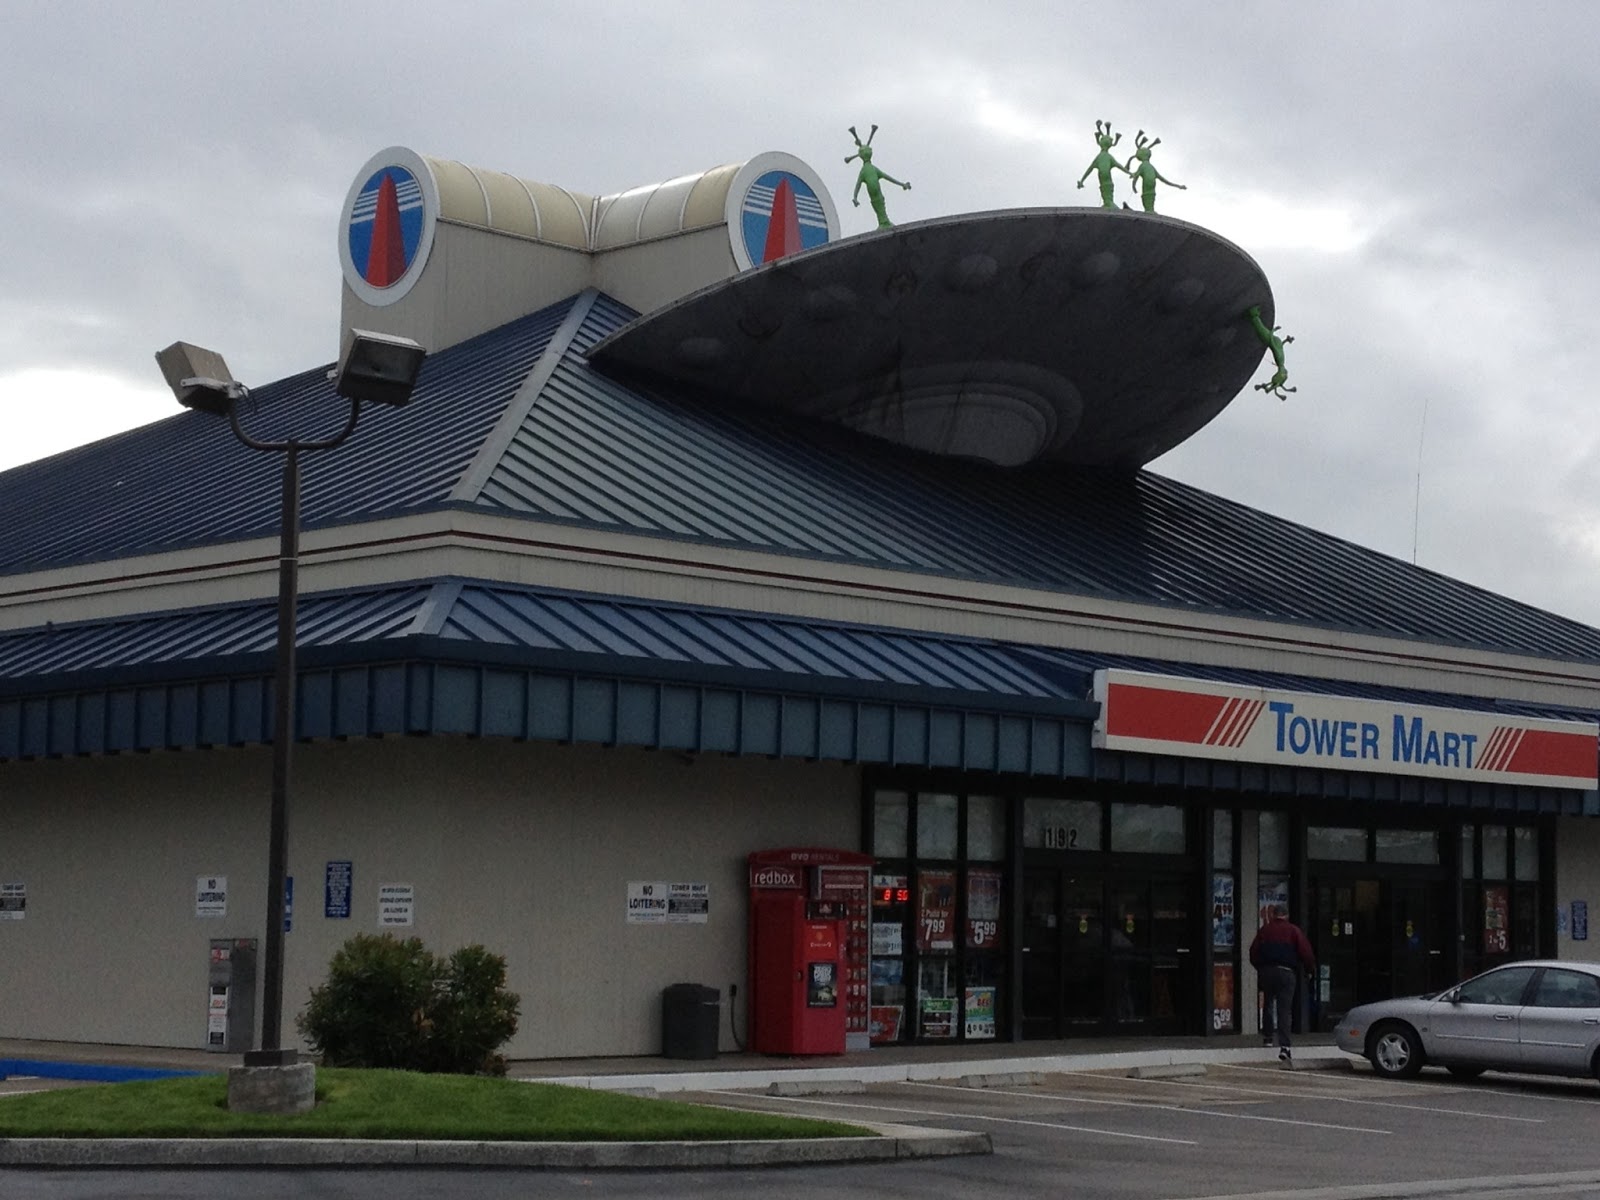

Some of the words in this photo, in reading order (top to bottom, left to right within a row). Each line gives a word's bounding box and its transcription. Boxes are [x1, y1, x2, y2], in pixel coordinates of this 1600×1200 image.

[1269, 701, 1379, 760] TOWER
[1392, 714, 1478, 769] MART
[755, 870, 795, 884] redbox
[642, 885, 653, 896] NO
[629, 898, 666, 909] LOITERING
